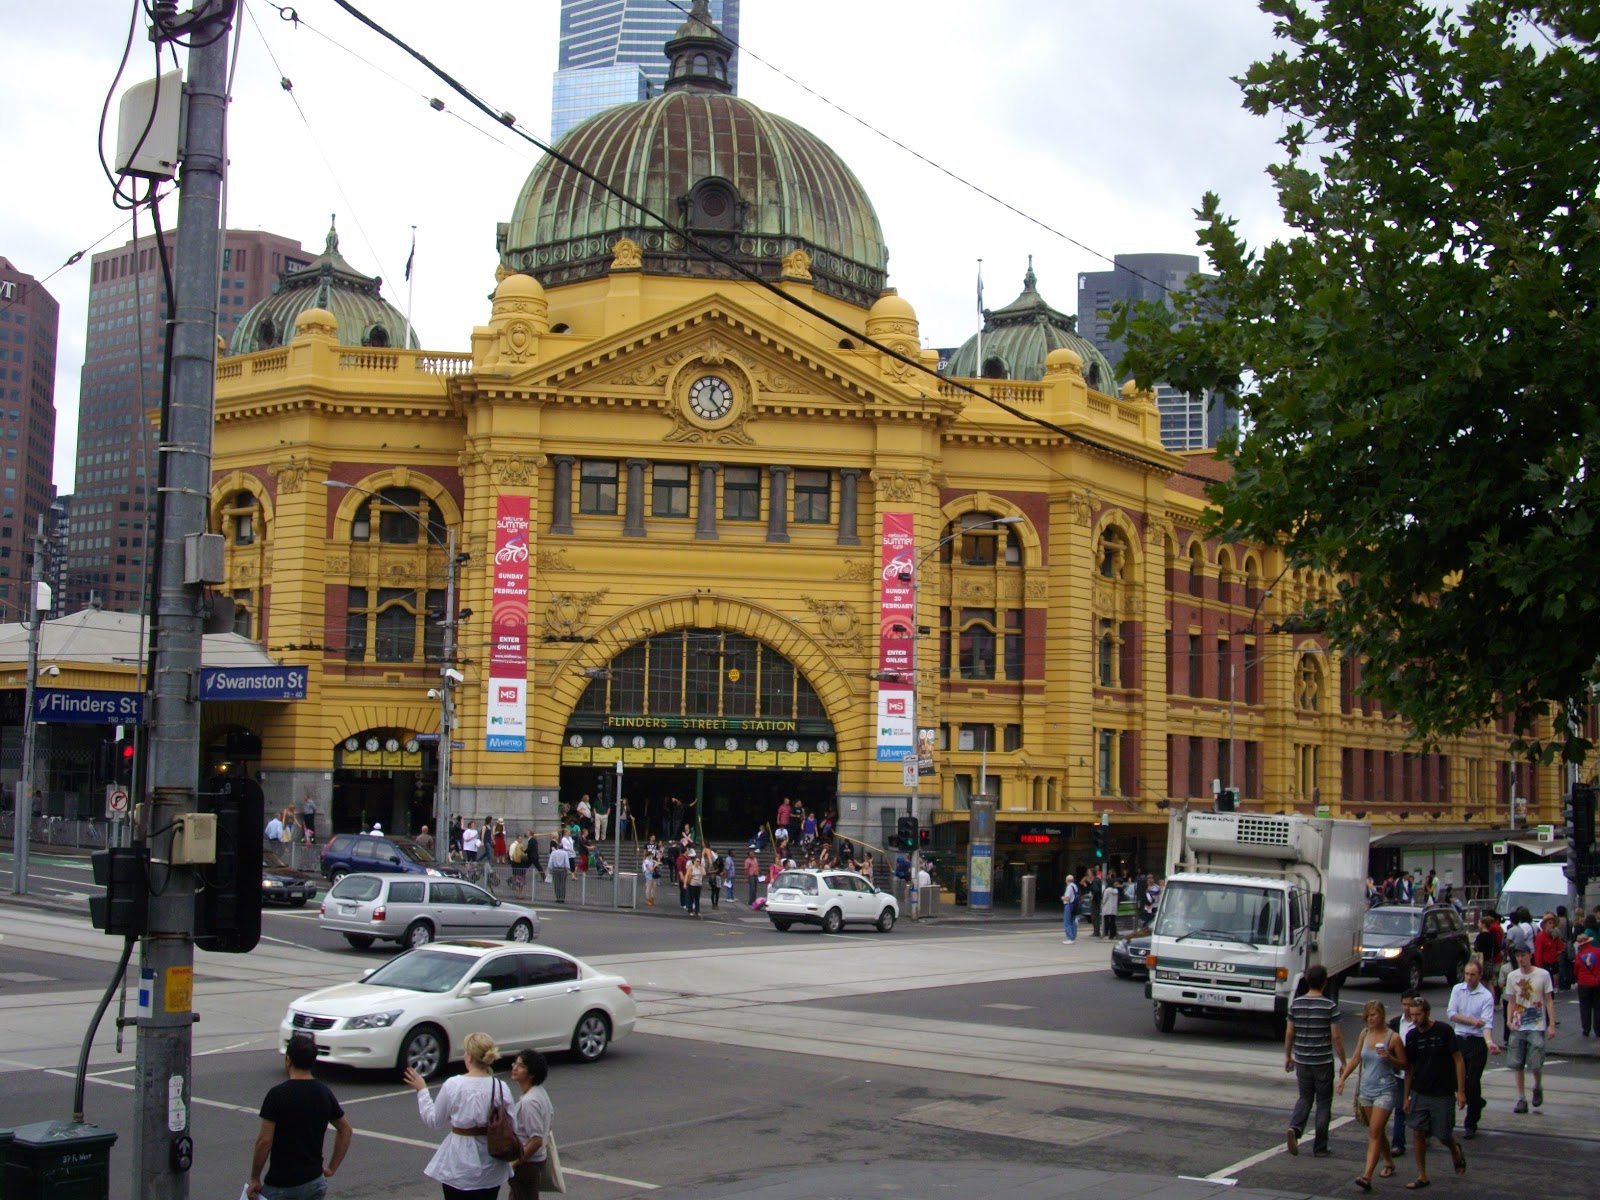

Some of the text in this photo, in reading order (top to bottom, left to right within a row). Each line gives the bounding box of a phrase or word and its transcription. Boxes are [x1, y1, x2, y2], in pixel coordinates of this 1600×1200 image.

[498, 572, 524, 580] SUNDAY
[494, 587, 527, 596] FEBRUARY
[216, 671, 304, 690] Swanston St
[283, 691, 291, 699] 22
[295, 691, 303, 699] 40
[500, 690, 516, 699] MS
[51, 693, 138, 714] Flinders St
[888, 702, 904, 711] MS
[608, 716, 796, 731] FLINDERS STREET STATION
[1193, 961, 1236, 973] ISUZU
